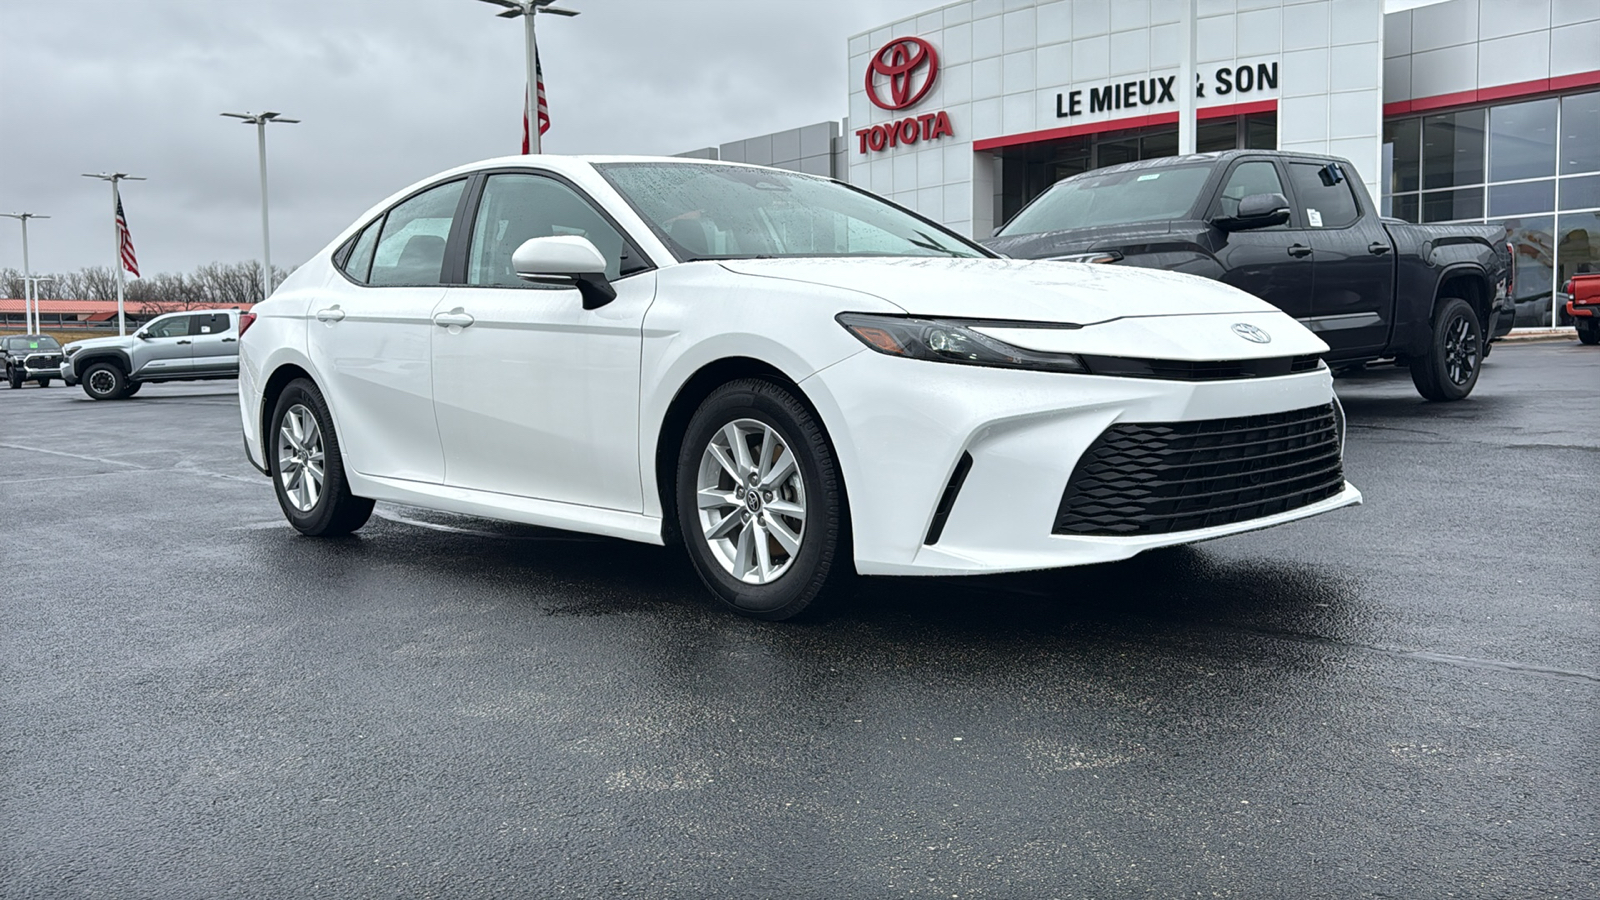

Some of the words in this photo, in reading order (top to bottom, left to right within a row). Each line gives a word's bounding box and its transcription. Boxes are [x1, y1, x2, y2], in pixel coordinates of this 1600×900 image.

[1056, 90, 1082, 118] LE
[1090, 75, 1176, 113] MIEUX
[1215, 61, 1278, 96] SON
[855, 111, 954, 155] TOYOTA
